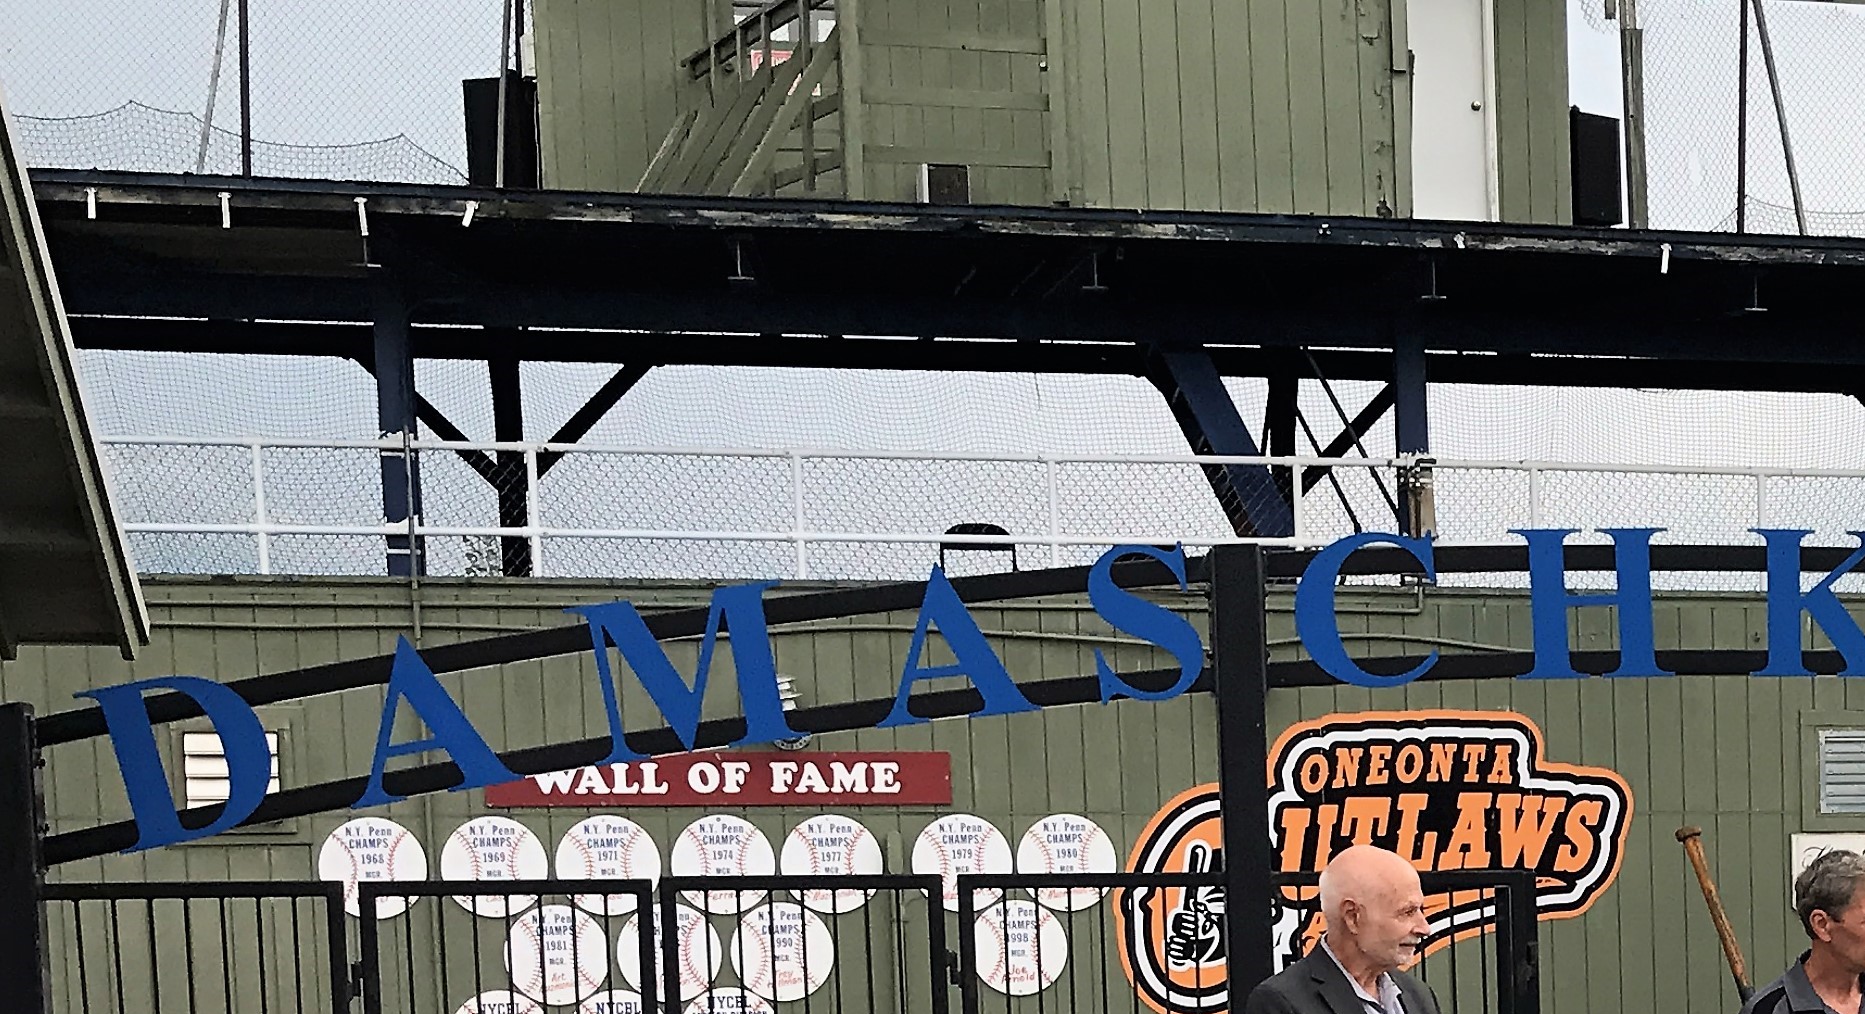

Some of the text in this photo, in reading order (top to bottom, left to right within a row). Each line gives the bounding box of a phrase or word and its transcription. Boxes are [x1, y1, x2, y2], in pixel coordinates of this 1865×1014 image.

[1300, 743, 1513, 793] ONEONTA
[533, 761, 902, 795] WALL OF FAME
[368, 826, 392, 836] Penn
[492, 825, 515, 836] Penn
[606, 824, 629, 834] Penn
[721, 823, 744, 833] Penn
[829, 823, 852, 833] Penn
[960, 822, 982, 833] Penn
[1064, 821, 1086, 832] Penn
[349, 838, 389, 849] CHAMPS
[473, 837, 512, 848] CHAMPS
[587, 837, 625, 849] CHAMPS
[702, 835, 741, 845] CHAMPS
[812, 837, 850, 847] CHAMPS
[942, 834, 980, 844] CHAMPS
[1046, 833, 1083, 844] CHAMPS
[360, 853, 385, 865] 1968
[483, 851, 506, 863] 1969
[597, 851, 618, 862] 1971
[712, 850, 734, 860] 1974
[821, 851, 842, 862] 1977
[951, 848, 973, 860] 1979
[1056, 848, 1078, 859] 1980
[554, 913, 576, 923] Pen
[1018, 908, 1039, 917] Pen
[536, 926, 574, 936] CHAMPS
[762, 925, 800, 935] CAMPS
[1000, 921, 1037, 930] CHAMPS
[546, 940, 568, 951] 1981
[773, 938, 793, 948] 990
[1008, 964, 1028, 975] Joe
[596, 1002, 641, 1014] NYCBL
